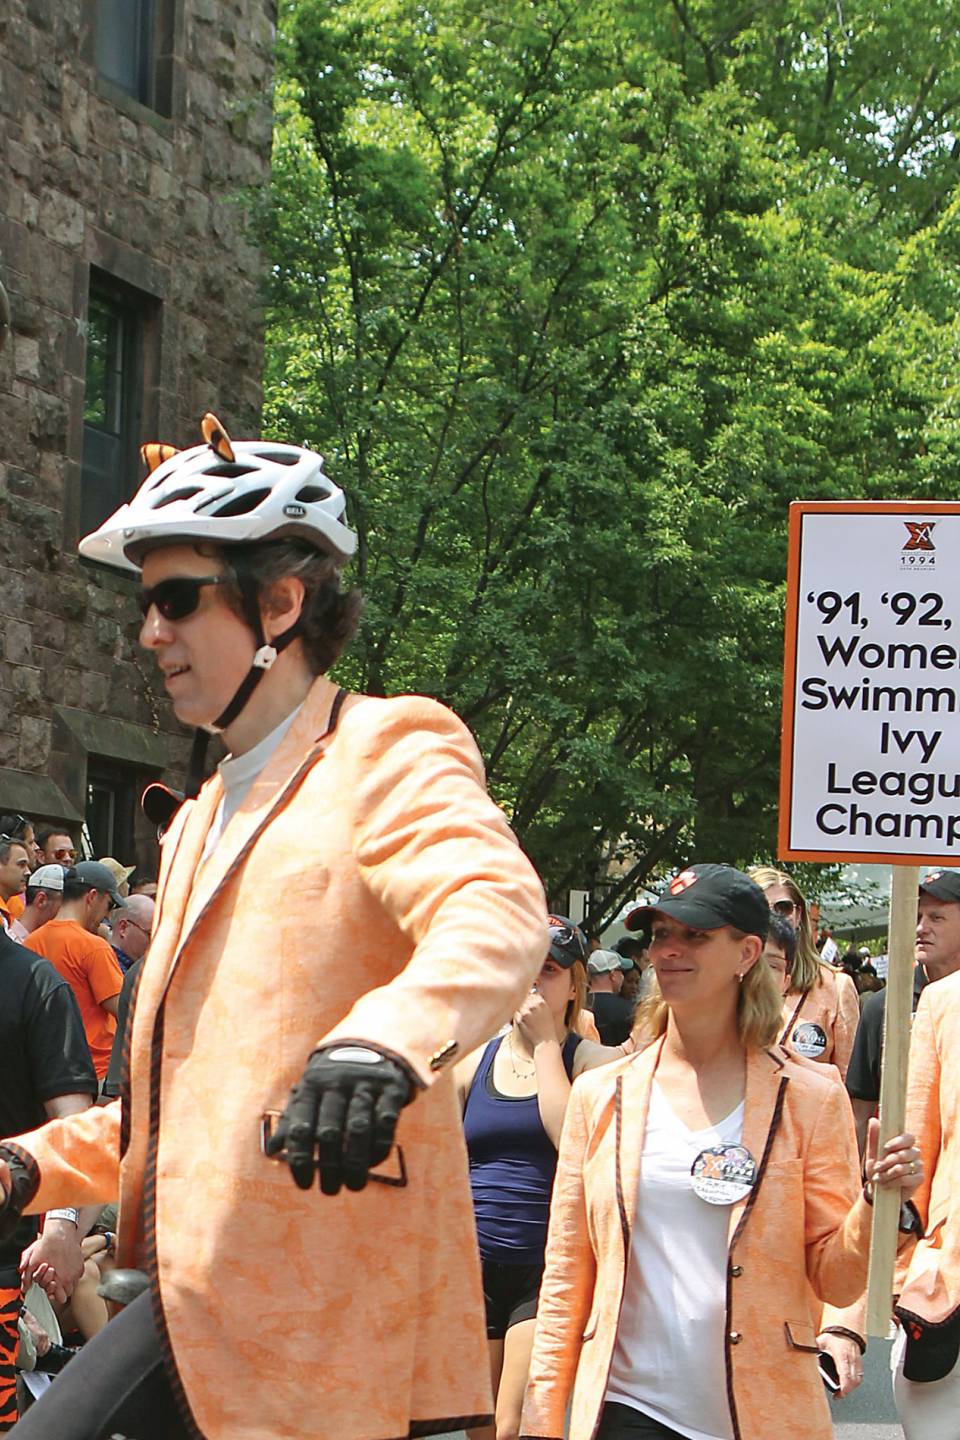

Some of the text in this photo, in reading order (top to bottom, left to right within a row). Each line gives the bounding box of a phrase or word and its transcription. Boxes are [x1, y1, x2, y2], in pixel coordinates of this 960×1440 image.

[900, 556, 935, 564] 1994
[817, 635, 960, 670] Wome
[881, 722, 942, 763] Ivy
[828, 763, 960, 805] Leagu
[816, 803, 960, 846] Champ
